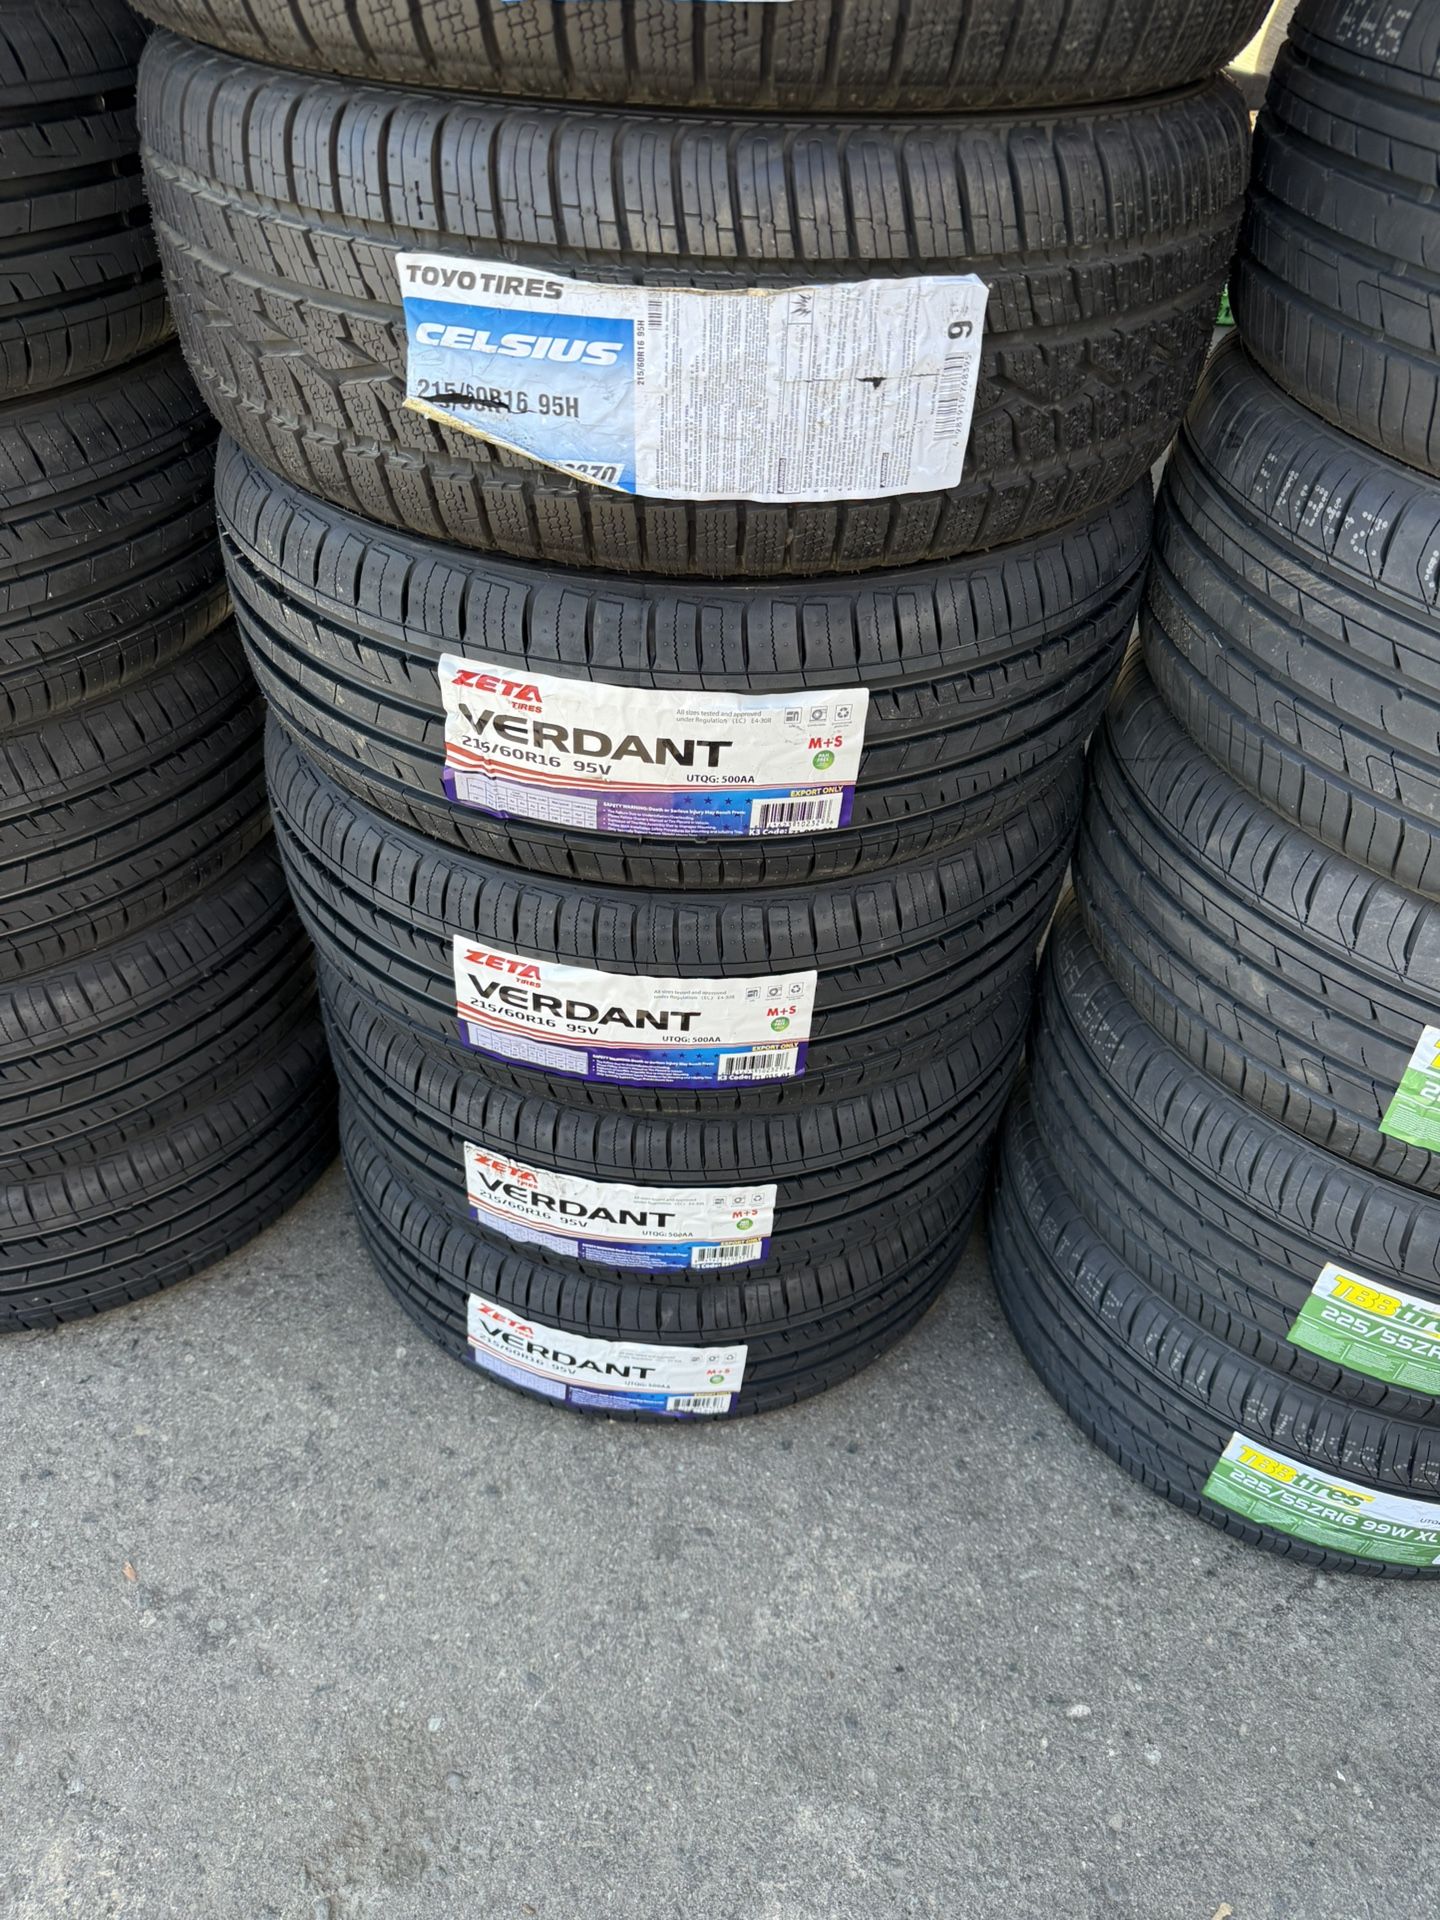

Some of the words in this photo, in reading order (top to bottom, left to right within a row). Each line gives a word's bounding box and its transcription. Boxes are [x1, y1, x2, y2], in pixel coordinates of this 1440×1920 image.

[406, 264, 476, 290] TOYO
[480, 273, 564, 299] TIRES
[415, 322, 624, 366] CELSIUS
[637, 320, 645, 336] 95H
[636, 337, 645, 386] 215/60R16
[539, 394, 579, 418] 95H
[451, 669, 543, 703] ZETA
[512, 701, 543, 714] TIRES
[459, 703, 733, 768] VERDANT
[808, 736, 843, 749] M+S
[462, 735, 561, 769] 215/60R16
[573, 760, 612, 776] 95V
[686, 775, 719, 784] UTQG:
[721, 775, 755, 784] 500AA
[790, 788, 822, 797] EXPORT
[823, 786, 843, 794] ONLY
[464, 949, 541, 980] ZETA
[515, 977, 541, 989] TIRES
[467, 973, 701, 1031] VERDANT
[470, 996, 556, 1028] 215/60R16
[566, 1023, 599, 1035] 95V
[766, 1005, 797, 1017] M+S
[474, 1153, 538, 1183] ZETA
[477, 1170, 675, 1227] VERDANT
[480, 1189, 551, 1220] 215/60R16
[559, 1217, 588, 1228] 95V
[732, 1208, 758, 1219] M+S
[477, 1302, 534, 1335] ZETA
[479, 1317, 656, 1379] VERDANT
[1230, 1467, 1359, 1526] 225/55ZR16
[1360, 1519, 1415, 1539] 99W
[1414, 1531, 1438, 1543] XL
